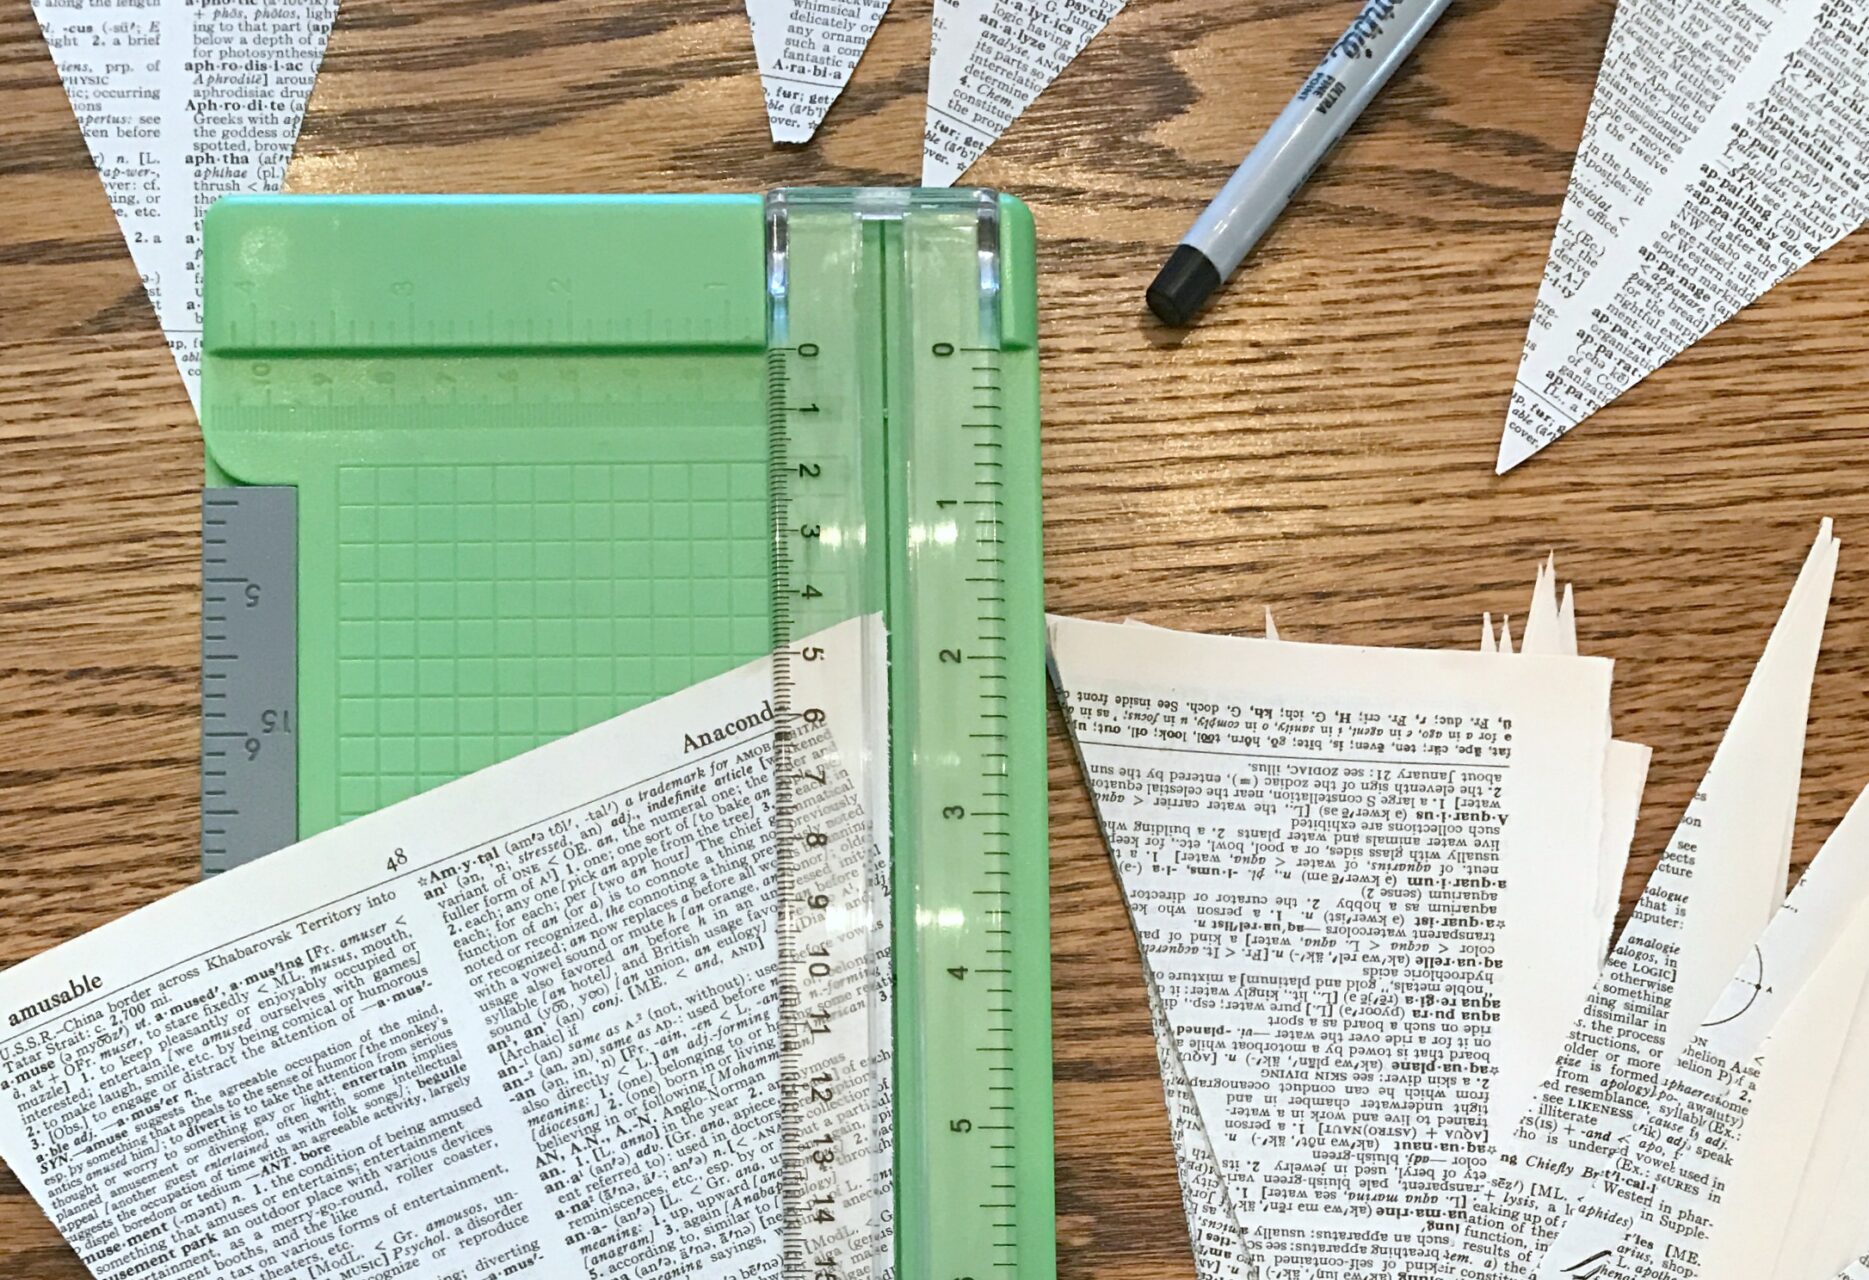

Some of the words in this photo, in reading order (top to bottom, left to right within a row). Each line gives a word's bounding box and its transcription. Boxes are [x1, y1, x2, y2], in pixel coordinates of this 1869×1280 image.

[1313, 75, 1336, 97] FINE
[1316, 82, 1346, 115] ULTRA
[797, 343, 820, 358] 0
[932, 342, 954, 358] 0
[798, 403, 820, 413] 1
[799, 463, 821, 478] 2
[935, 498, 957, 509] 1
[800, 524, 821, 538] 3
[801, 584, 823, 600] 4
[802, 647, 824, 662] 5
[939, 649, 962, 664] 2
[803, 708, 825, 724] 6
[804, 770, 826, 784] 7
[1395, 767, 1456, 784] January
[637, 766, 706, 803] trademark
[646, 783, 707, 813] indefinite
[713, 764, 753, 787] article
[943, 805, 965, 820] 3
[1379, 821, 1463, 837] collections
[807, 832, 827, 848] 8
[386, 846, 408, 872] 48
[807, 894, 830, 910] 9
[457, 931, 519, 962] function
[809, 948, 831, 977] 10
[105, 986, 152, 1013] border
[157, 966, 201, 992] across
[203, 929, 293, 972] Khabarovsk
[947, 966, 969, 981] 4
[1361, 966, 1399, 981] acids
[1402, 968, 1494, 985] hydrochloric
[7, 973, 103, 1027] amusable
[108, 1001, 146, 1027] 2,700
[809, 1009, 832, 1036] 11
[1230, 1040, 1306, 1054] motorboat
[1, 1050, 42, 1074] Tatar
[98, 1057, 163, 1090] entertain
[1259, 1067, 1309, 1080] DIVING
[1313, 1070, 1348, 1081] SKIN
[662, 1071, 767, 1120] Anglo-Norman
[810, 1071, 833, 1104] 12
[1286, 1095, 1350, 1110] chamber
[1359, 1098, 1443, 1113] underwater
[950, 1118, 972, 1134] 5
[534, 1120, 602, 1153] believing
[812, 1133, 835, 1165] 13
[1310, 1148, 1399, 1166] bluish-green
[244, 1199, 301, 1229] outdoor
[813, 1196, 836, 1225] 14
[120, 1205, 178, 1234] boredom
